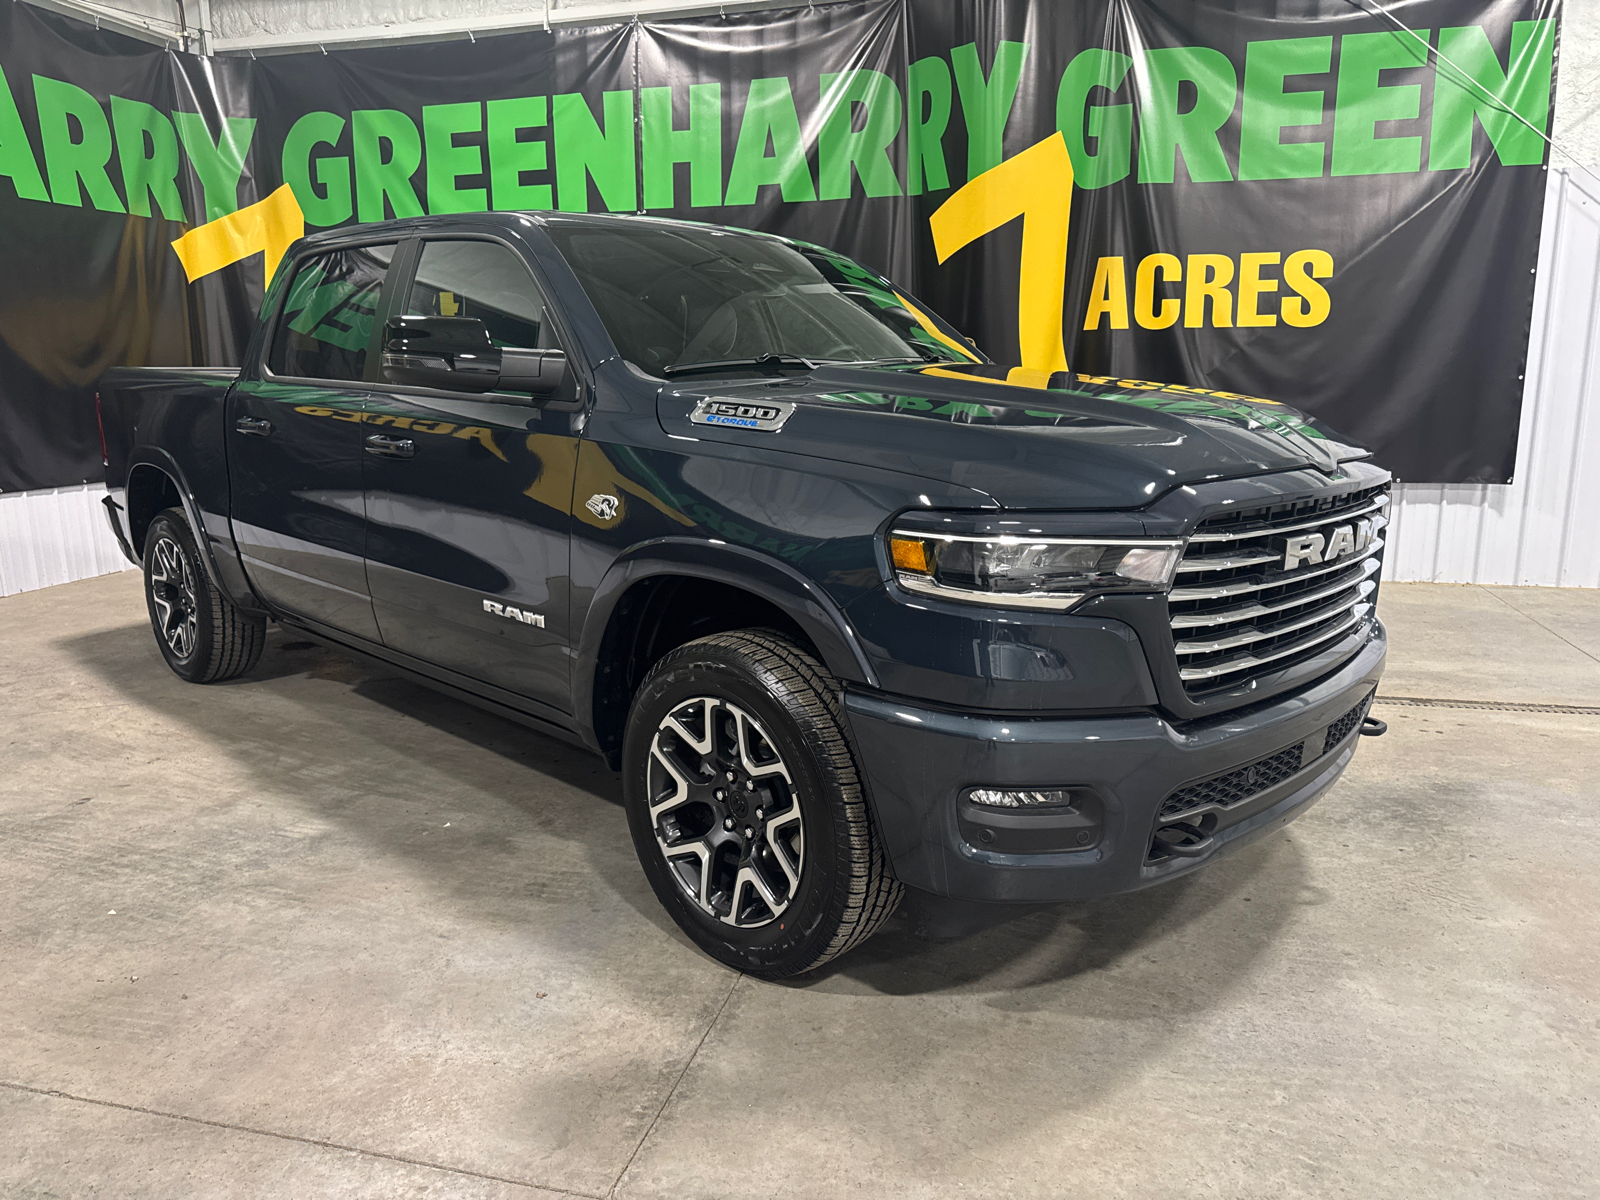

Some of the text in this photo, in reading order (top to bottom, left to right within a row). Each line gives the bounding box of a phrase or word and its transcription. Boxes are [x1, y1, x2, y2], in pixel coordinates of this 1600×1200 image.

[282, 89, 637, 226] GREEN
[641, 18, 1556, 209] HARRY GREEN
[929, 130, 1334, 372] 7 ACRES
[711, 403, 776, 419] 1500
[1283, 512, 1389, 572] RAM
[482, 599, 545, 629] RAM
